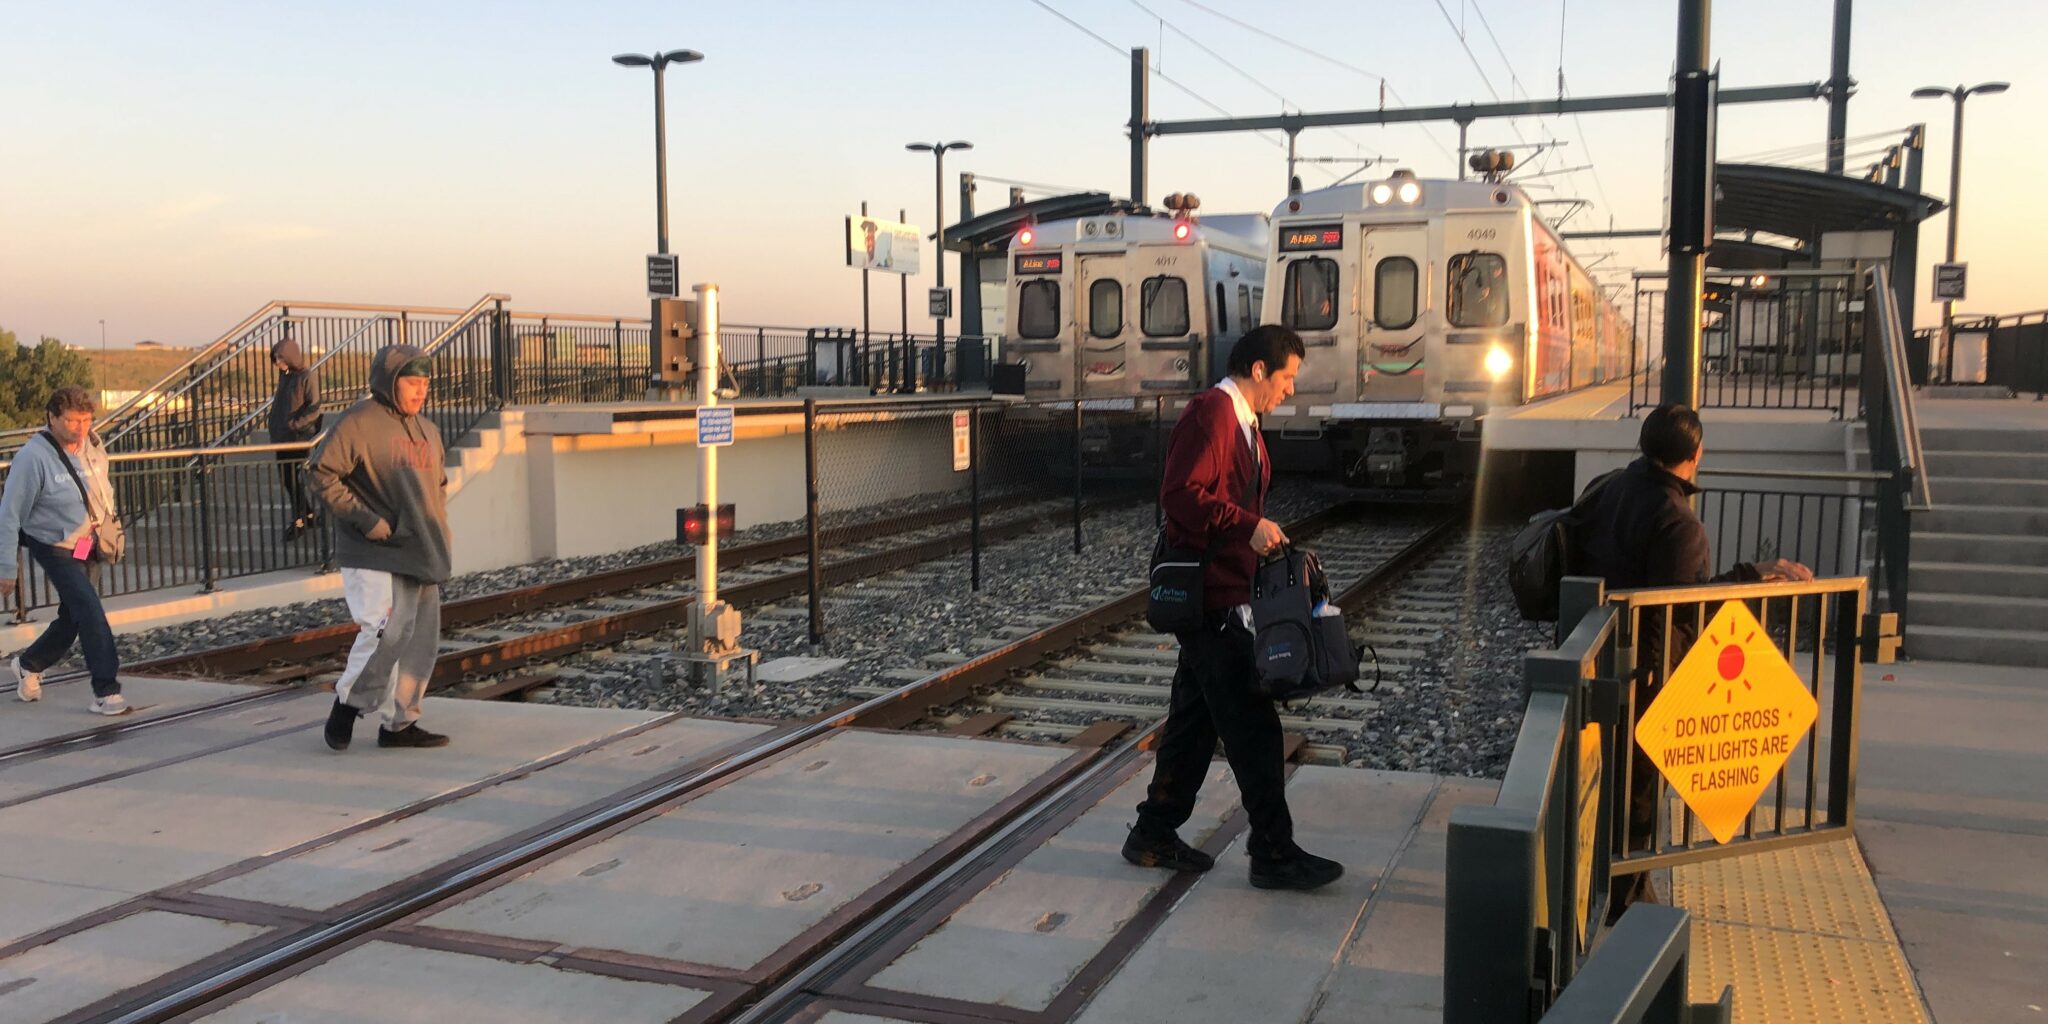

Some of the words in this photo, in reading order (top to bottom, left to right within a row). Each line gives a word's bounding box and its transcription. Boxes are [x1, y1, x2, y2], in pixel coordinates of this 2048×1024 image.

[1467, 228, 1496, 240] 4049
[1155, 256, 1178, 265] 4017
[1675, 717, 1696, 738] DO
[1700, 713, 1729, 736] NOT
[1732, 708, 1780, 731] CROSS
[1663, 744, 1705, 768] WHEN
[1709, 738, 1758, 762] LIGHTS
[1760, 734, 1789, 756] ARE
[1691, 765, 1759, 792] FLASHING
